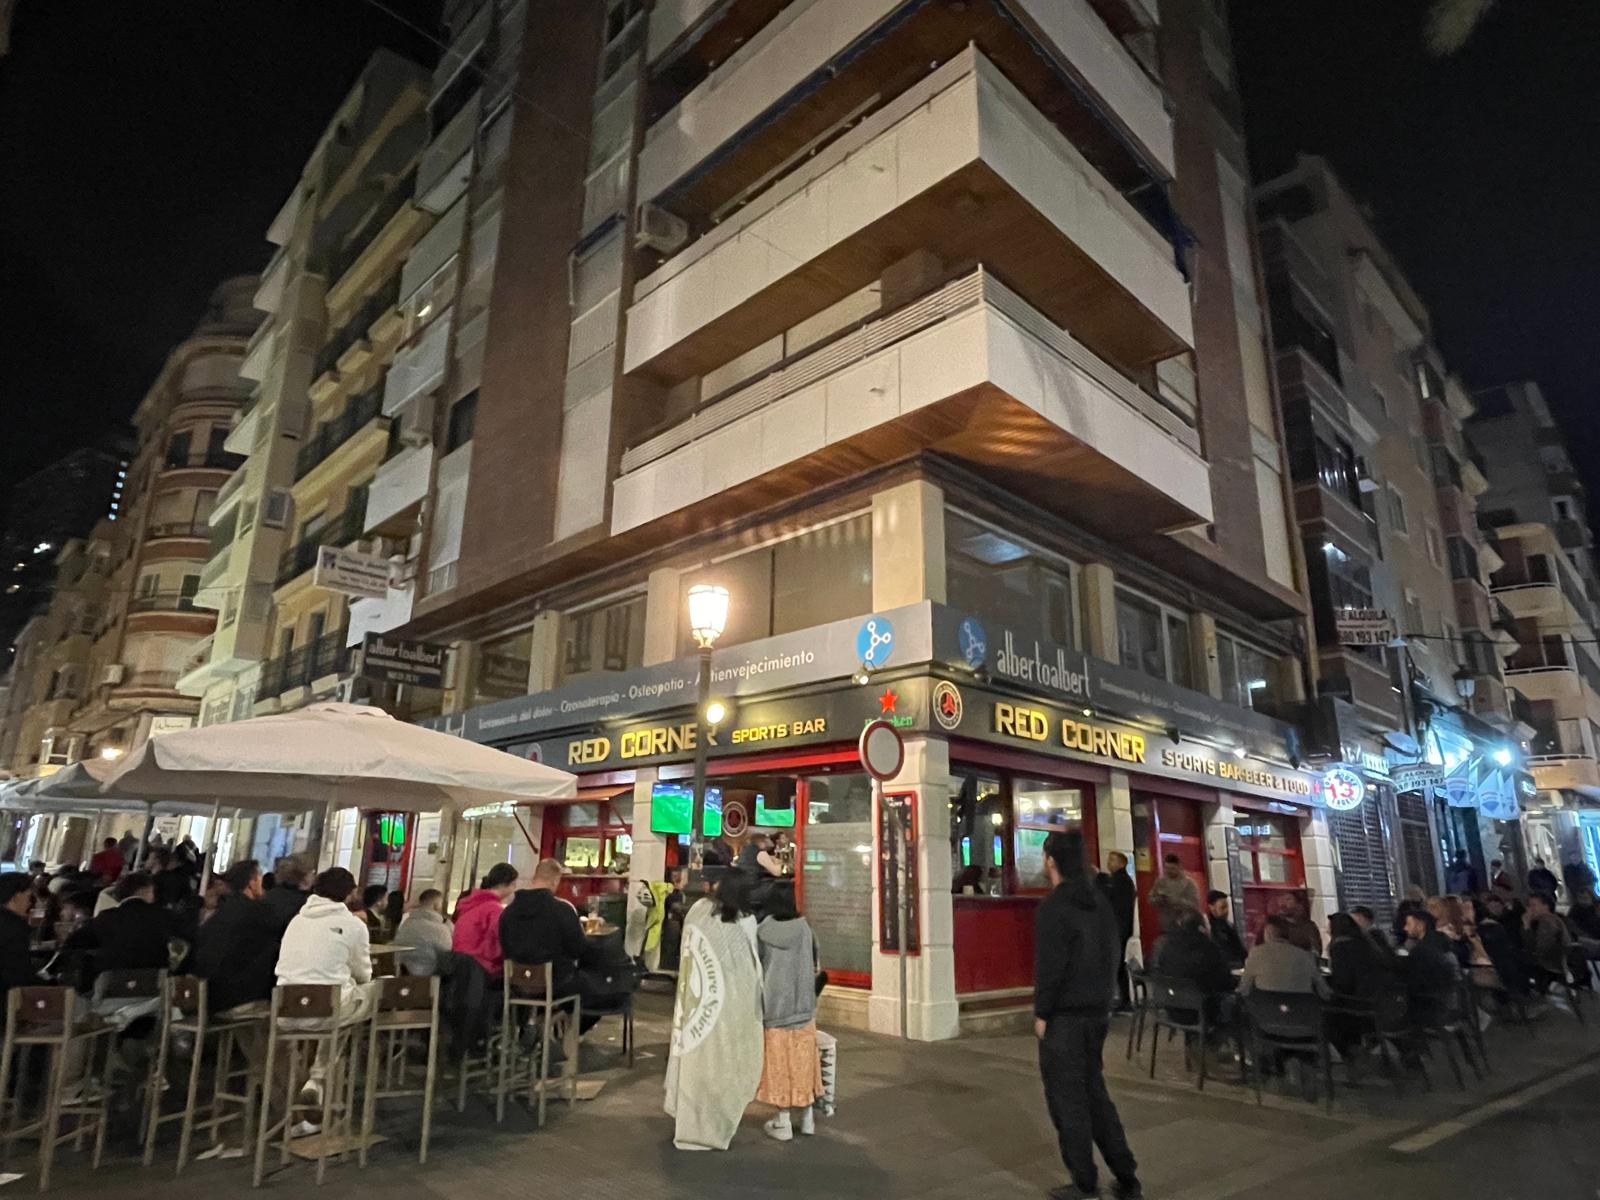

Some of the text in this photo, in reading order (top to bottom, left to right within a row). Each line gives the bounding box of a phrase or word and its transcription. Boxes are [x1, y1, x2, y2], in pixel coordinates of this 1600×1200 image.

[1347, 609, 1388, 620] ALQUILA
[694, 650, 815, 687] Atienvejecimiento
[997, 630, 1092, 698] albertoalbert
[567, 737, 612, 766] RED
[731, 723, 787, 744] SPORTS
[793, 718, 826, 736] BAR
[995, 702, 1049, 742] RED
[1062, 718, 1146, 764] CORNER
[1164, 751, 1216, 777] SPORTS
